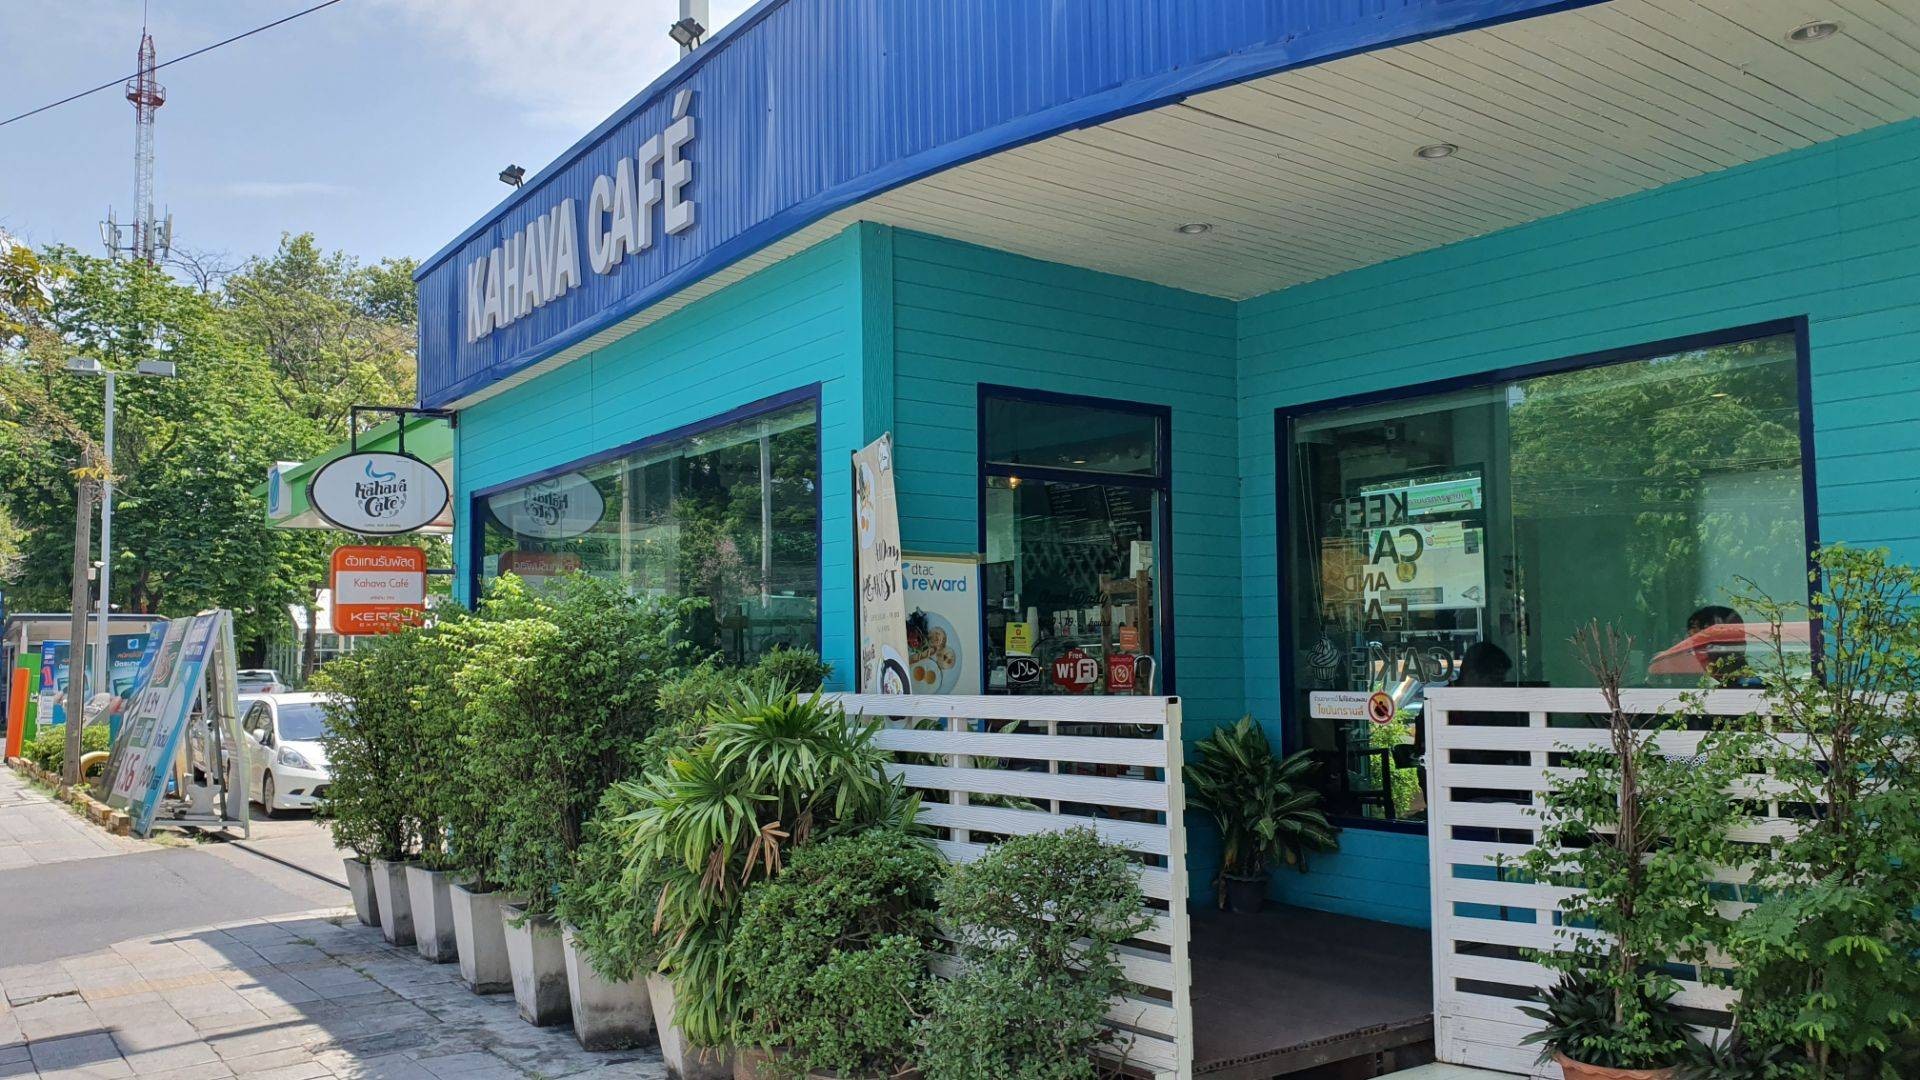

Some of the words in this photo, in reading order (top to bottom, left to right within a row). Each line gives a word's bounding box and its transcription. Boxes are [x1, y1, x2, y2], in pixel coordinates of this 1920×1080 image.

[467, 198, 582, 344] KAHAVA
[588, 88, 695, 275] CAFÉ
[345, 555, 415, 570] ตัวแทนรับพัสดุ
[911, 563, 935, 576] dtac
[353, 577, 387, 589] Kahava
[388, 577, 410, 589] Café
[911, 576, 967, 592] reward
[350, 611, 414, 622] KERRY
[1068, 650, 1083, 659] Free
